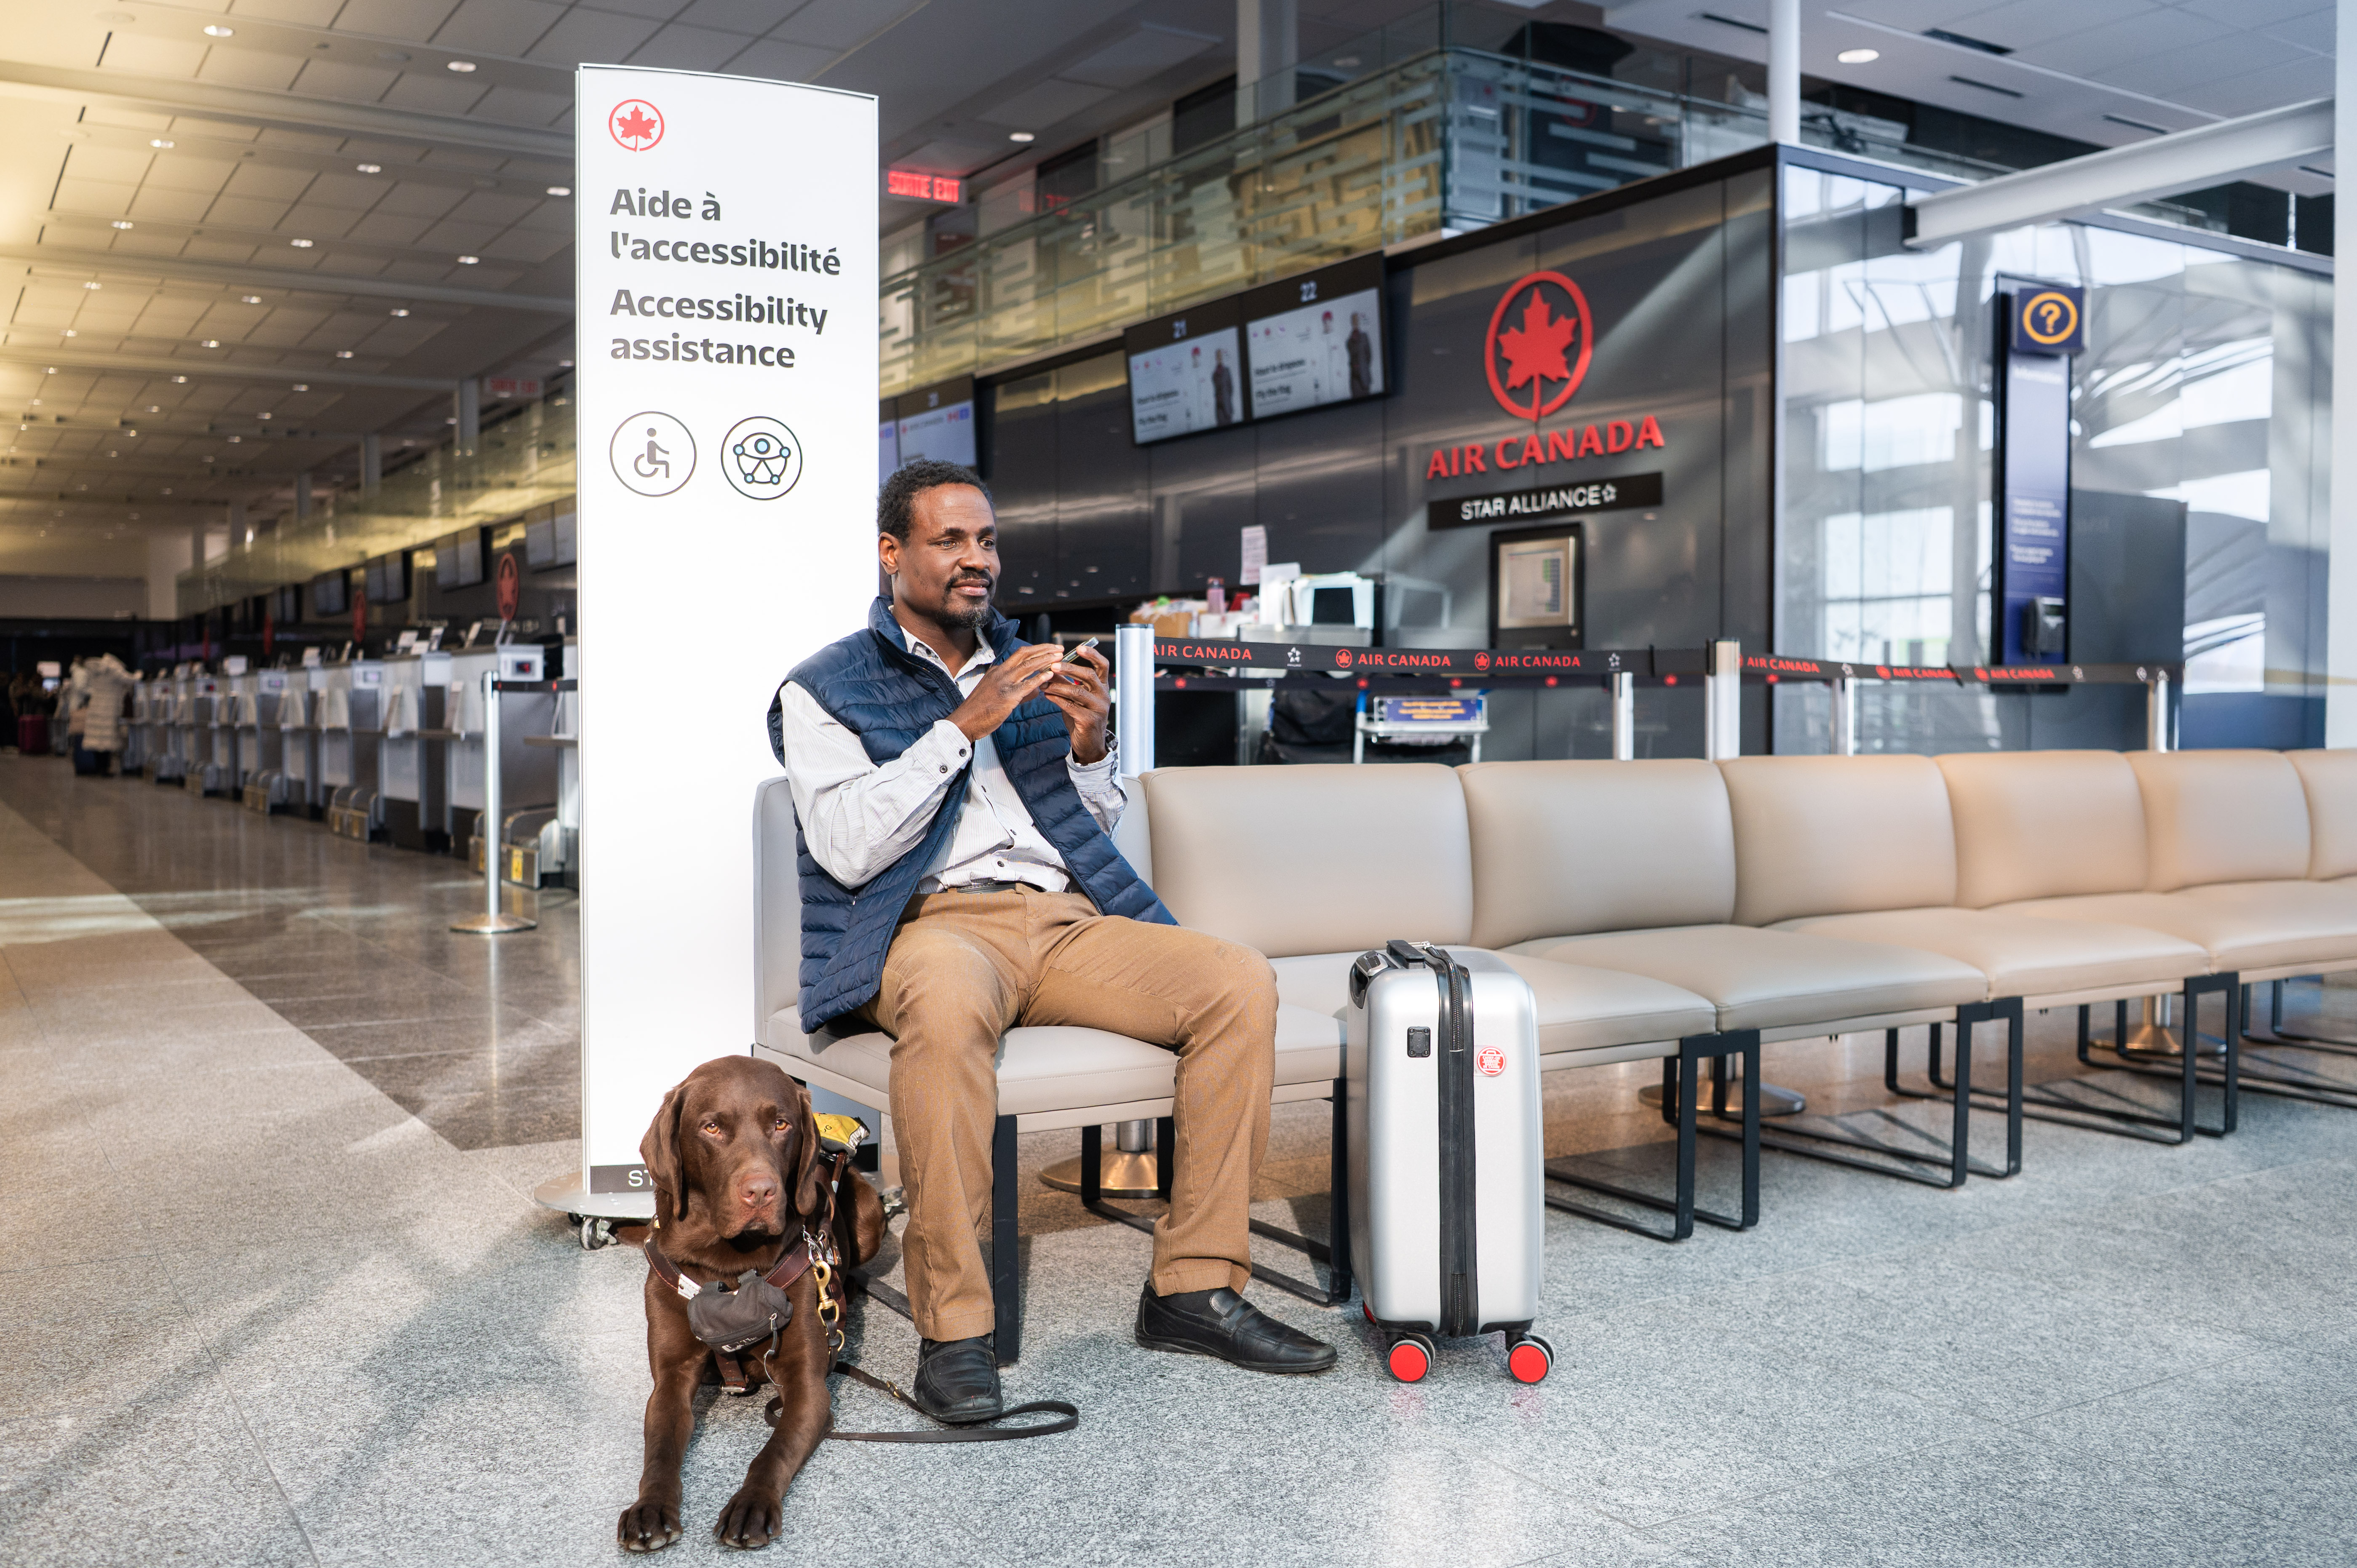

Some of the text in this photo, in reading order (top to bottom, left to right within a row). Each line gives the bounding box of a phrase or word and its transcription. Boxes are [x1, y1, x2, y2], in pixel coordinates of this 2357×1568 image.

[610, 188, 721, 221] Aide à
[611, 231, 841, 275] l'accessibilité
[1300, 281, 1317, 302] 22
[610, 289, 828, 335] Accessibility
[1173, 318, 1187, 339] 21
[610, 333, 795, 368] assistance
[1427, 415, 1665, 479] AIR CANADA
[1461, 485, 1601, 520] STAR ALLIANCE
[1182, 646, 1252, 660] CANADA
[1358, 653, 1451, 667] AIR CANADA
[1495, 656, 1580, 667] AIR CANADA
[1747, 657, 1820, 673] AIR CANADA
